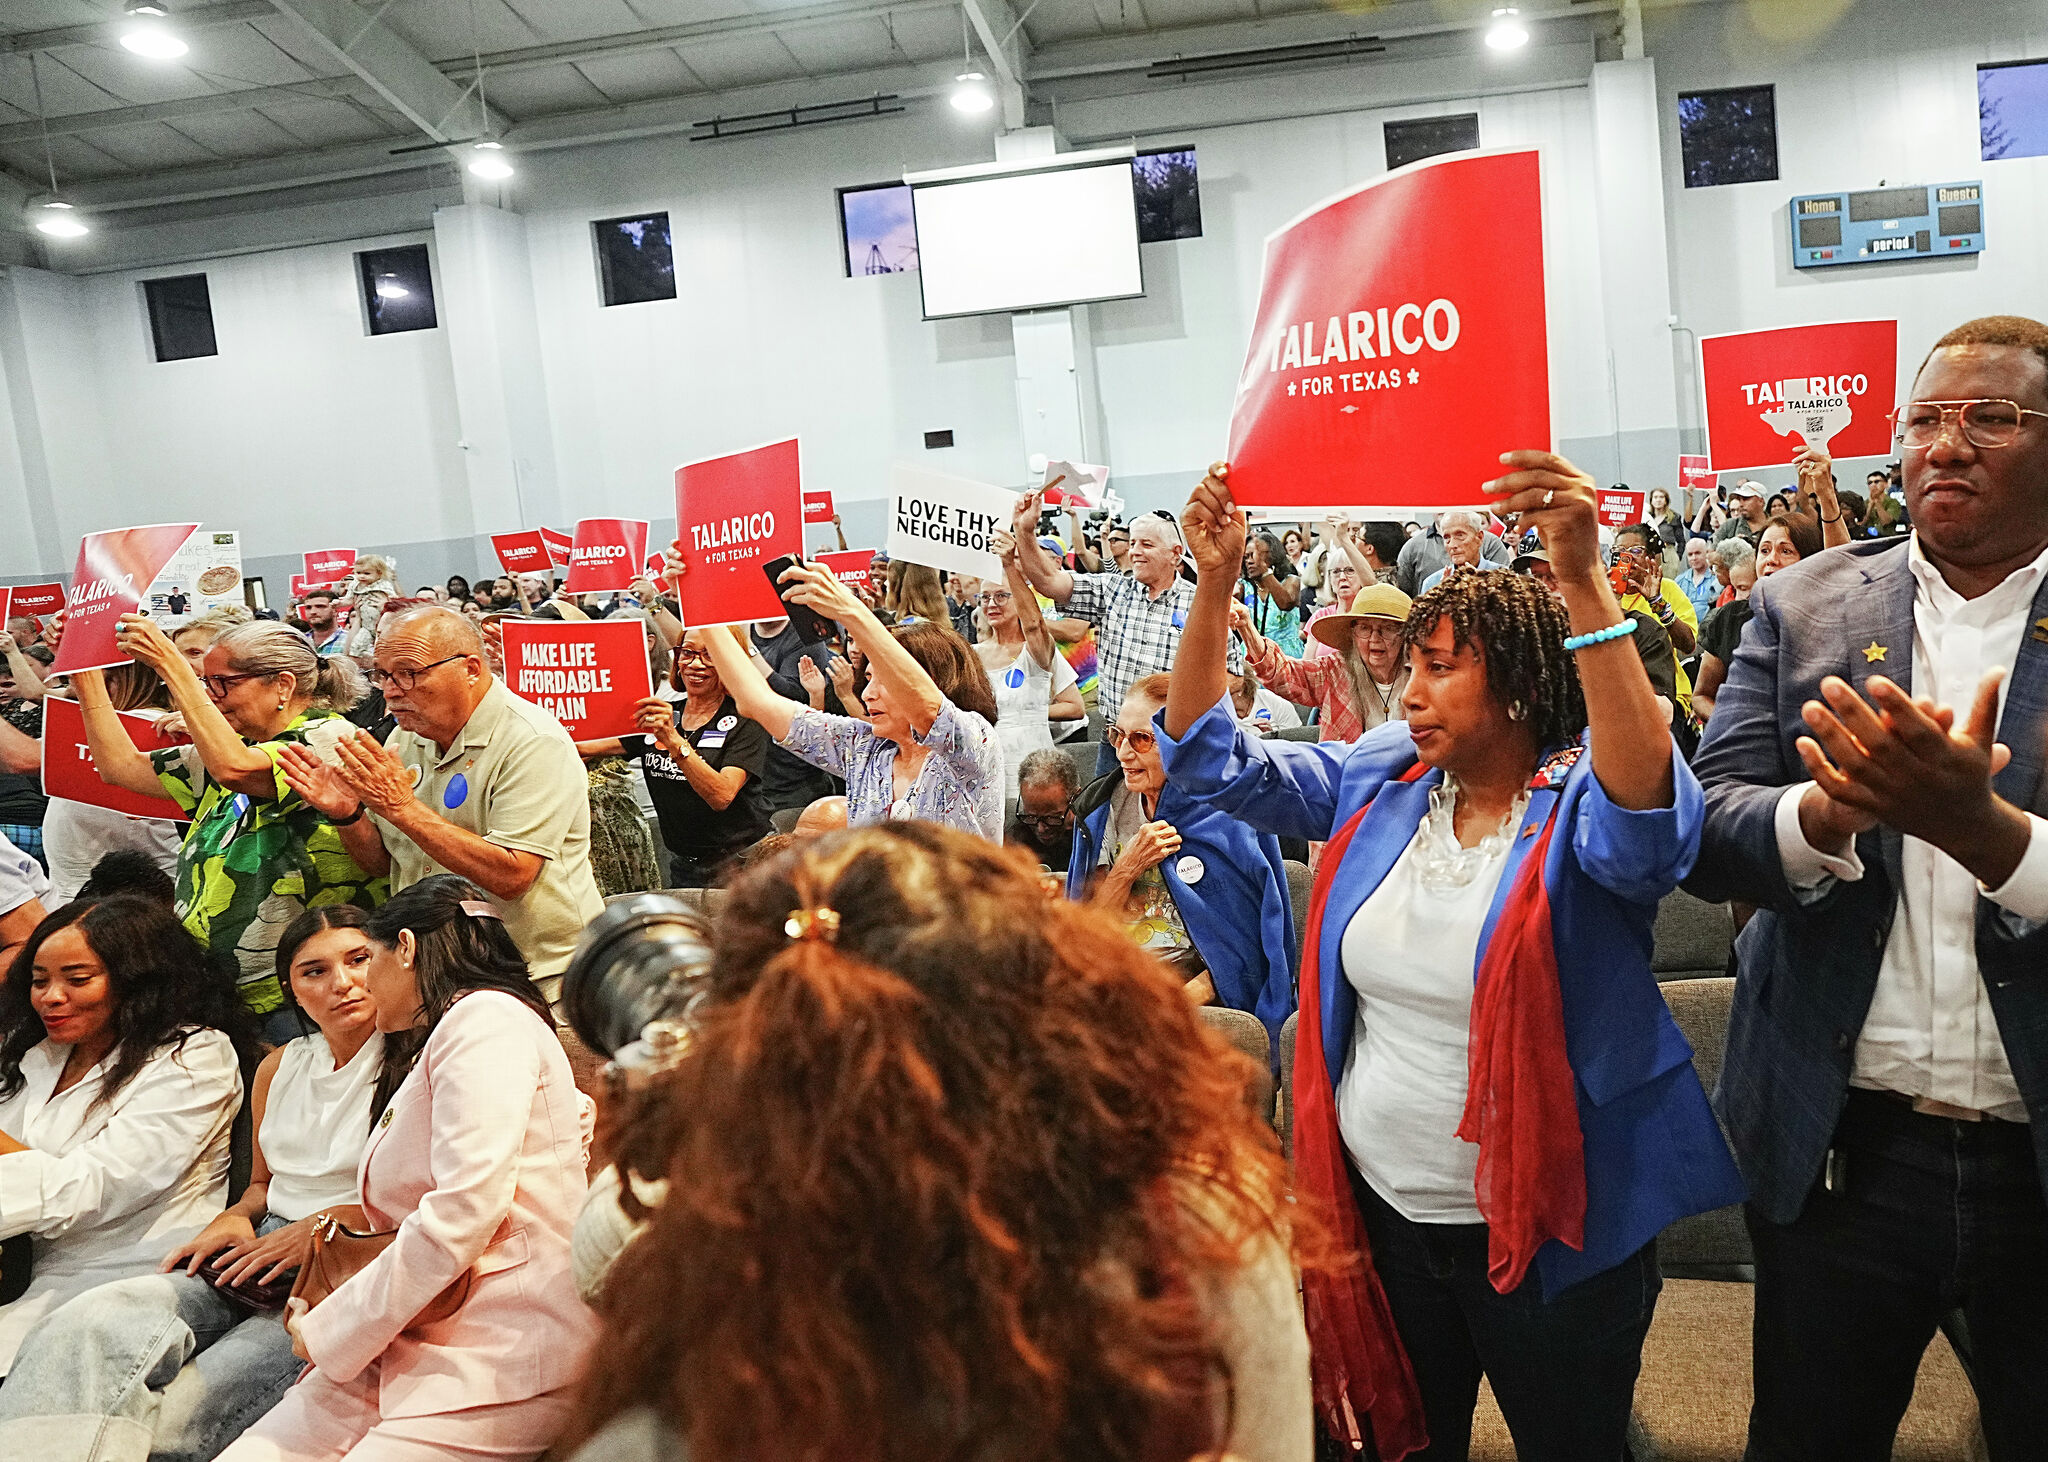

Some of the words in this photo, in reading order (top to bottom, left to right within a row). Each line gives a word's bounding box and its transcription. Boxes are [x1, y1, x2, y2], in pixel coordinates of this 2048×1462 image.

[1938, 188, 1978, 202] Guests
[1804, 200, 1836, 213] Home
[1872, 235, 1909, 253] period
[1270, 298, 1460, 372] TALARICO
[1302, 376, 1334, 397] FOR
[1339, 368, 1401, 392] TEXAS
[1741, 374, 1867, 405] TALRICO
[1788, 398, 1843, 409] TALARICO
[898, 496, 948, 524] LOVE
[955, 508, 1000, 534] THY
[691, 511, 774, 550] TALARICO
[502, 546, 537, 557] TALARICO
[572, 545, 626, 560] TALARICO
[712, 552, 726, 564] FOR
[728, 547, 753, 560] TEXAS
[835, 570, 866, 580] LARICO
[68, 573, 134, 608] TALARICO
[13, 596, 54, 604] TALARICO
[74, 608, 85, 619] FOR
[87, 604, 105, 616] TEXAS
[522, 642, 559, 667] MAKE
[560, 642, 597, 667] LIFE
[519, 669, 613, 694] AFFORDABLE
